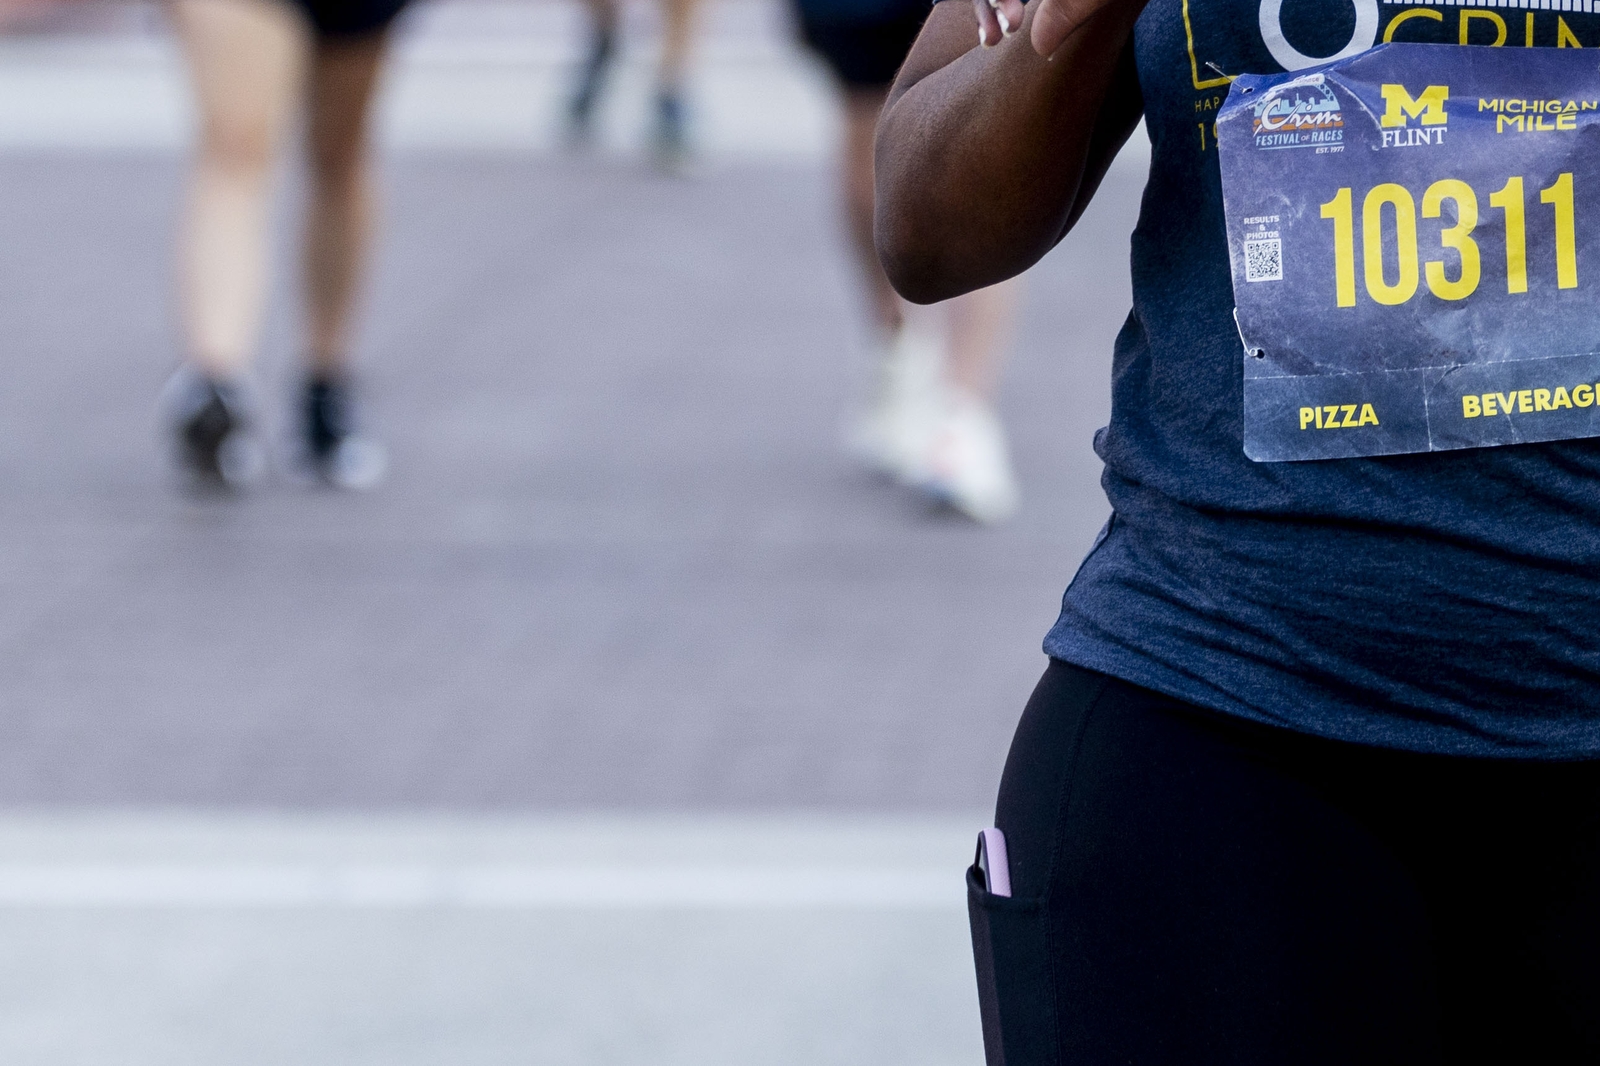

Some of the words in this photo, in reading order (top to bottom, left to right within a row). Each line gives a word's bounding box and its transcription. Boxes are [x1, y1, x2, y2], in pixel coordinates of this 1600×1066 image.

[1380, 84, 1449, 128] M
[1478, 98, 1598, 114] MICHIGAN
[1253, 97, 1342, 138] Crim
[1496, 112, 1577, 134] MILE
[1256, 133, 1300, 146] FESTIVAL
[1311, 130, 1343, 142] RACES
[1382, 127, 1447, 148] FLINT
[1244, 215, 1280, 224] RESULTS
[1246, 231, 1279, 240] PHOTOS
[1320, 172, 1578, 308] 10311
[1299, 403, 1379, 430] PIZZA
